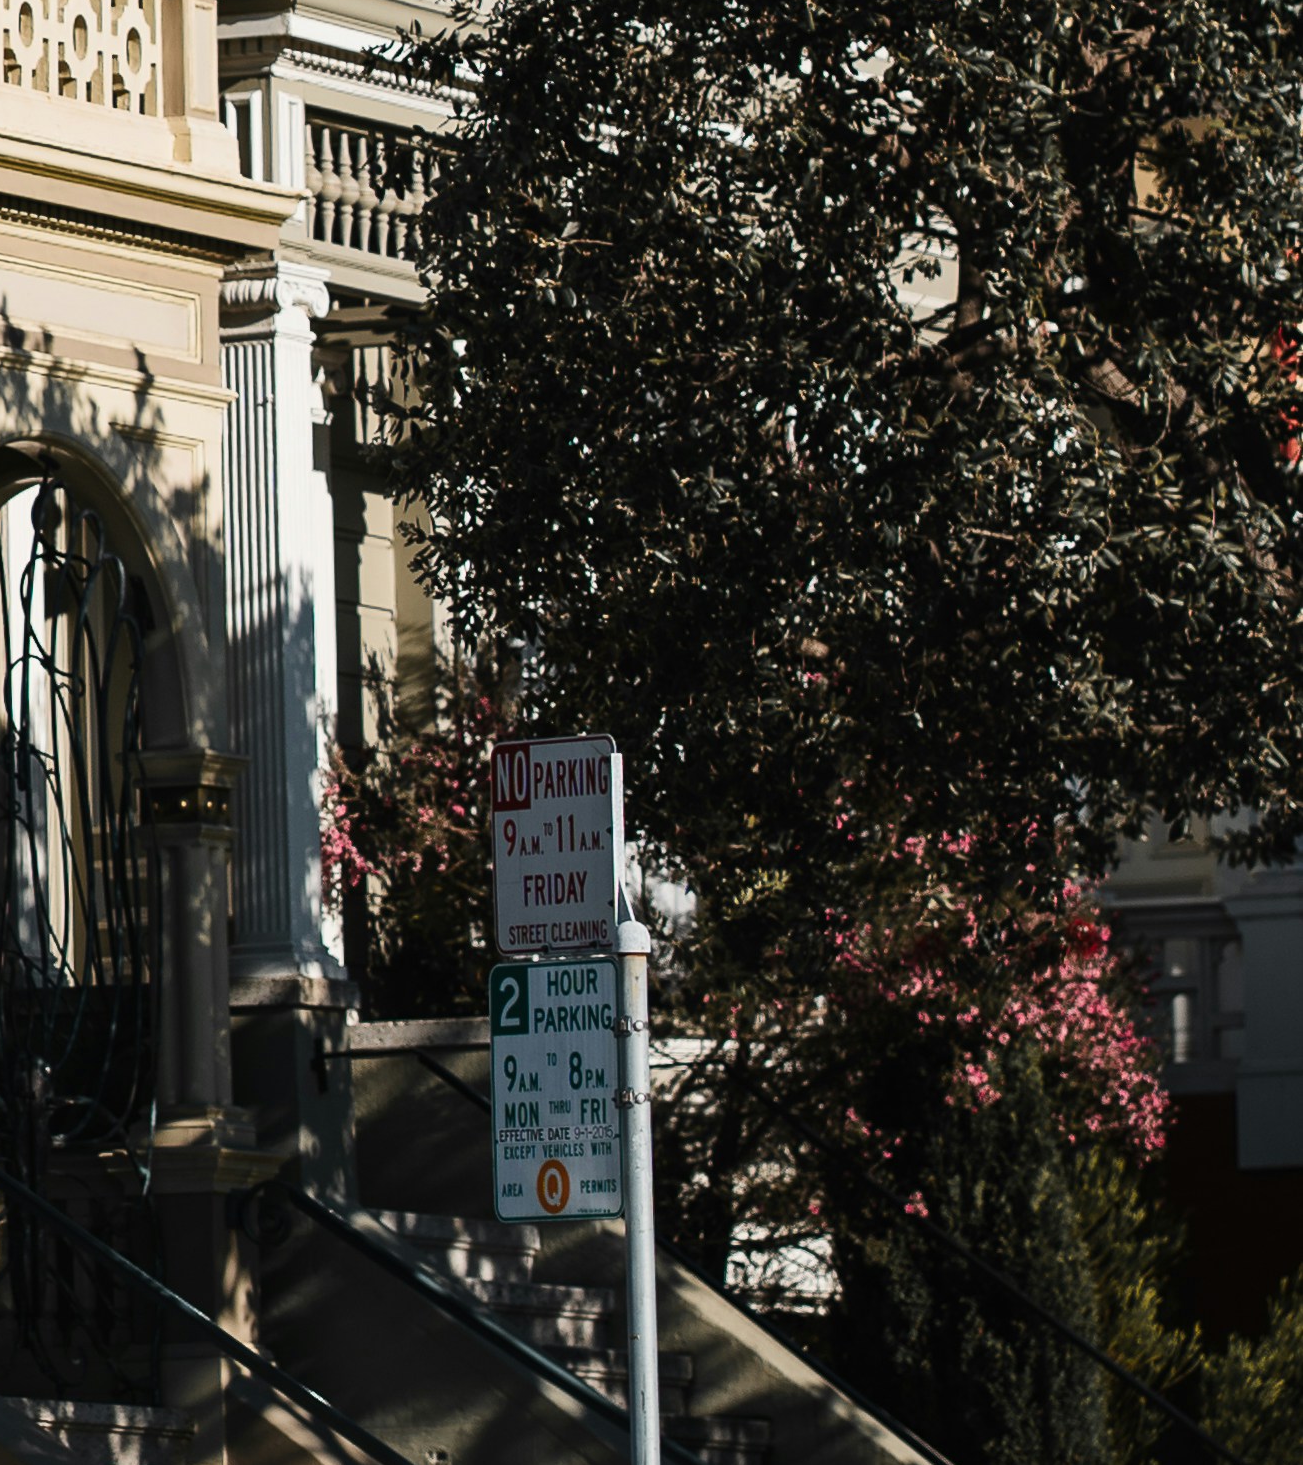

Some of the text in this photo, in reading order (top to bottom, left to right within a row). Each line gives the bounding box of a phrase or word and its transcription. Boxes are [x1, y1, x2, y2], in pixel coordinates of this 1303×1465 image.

[496, 750, 608, 803] NO PARKING
[503, 814, 605, 857] 9 A.M. TO 11 A.M.
[523, 871, 588, 907] FRIDAY
[509, 919, 608, 945] STREET CLEANING
[499, 969, 598, 1027] 2 HOUR
[534, 1003, 612, 1034] PARKING
[504, 1052, 608, 1092] 9 A.M. TO 8 P.M.
[504, 1098, 606, 1128] MON THRU FRI
[499, 1125, 614, 1143] EFFECTIVE DATE 9-1-2015
[504, 1142, 612, 1160] EXCEPT VEHICLES WITH
[501, 1167, 617, 1207] AREA Q PERMITS
